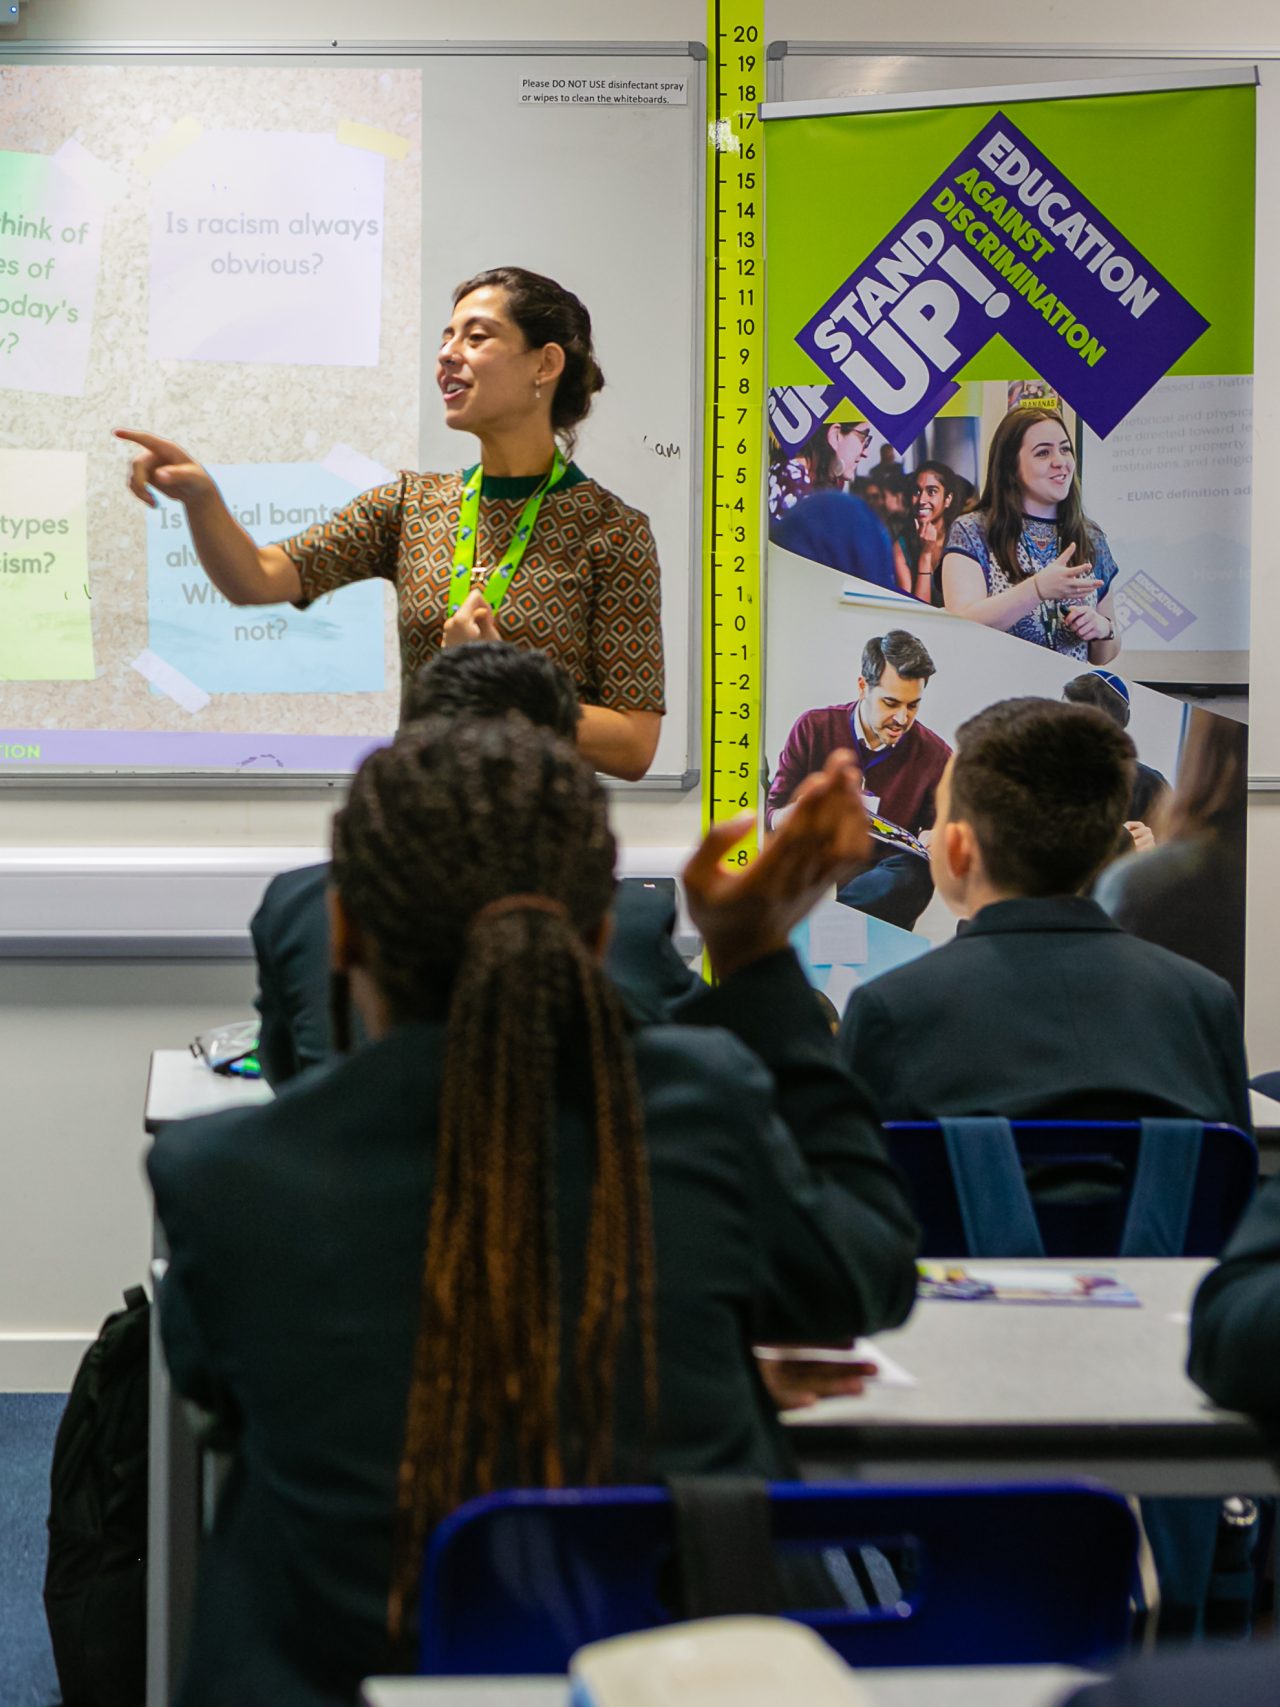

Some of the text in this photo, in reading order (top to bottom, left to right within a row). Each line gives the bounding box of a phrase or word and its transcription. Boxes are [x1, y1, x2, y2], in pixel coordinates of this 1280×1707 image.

[733, 26, 758, 43] 20
[738, 56, 756, 73] 19
[522, 79, 684, 91] Please DO NOT USE disinfectant spray
[533, 94, 558, 104] wipes
[560, 94, 570, 102] to
[571, 94, 595, 102] clean
[597, 94, 611, 102] the
[613, 94, 670, 104] whiteboards.
[738, 86, 756, 101] 18
[738, 113, 756, 130] 17
[737, 143, 756, 160] 16
[737, 173, 755, 189] 15
[737, 203, 755, 219] 14
[954, 168, 1055, 263] AGAINST
[165, 211, 379, 240] Is racism always
[977, 130, 1160, 319] EDUCATION
[61, 222, 91, 245] of
[737, 232, 755, 248] 13
[27, 258, 55, 280] of
[210, 253, 324, 276] obvious?
[737, 260, 755, 276] 12
[932, 186, 1108, 367] DISCRIMINATION
[738, 289, 754, 306] 11
[813, 218, 945, 363] STAND
[736, 319, 755, 335] 10
[839, 244, 1011, 416] UP!
[739, 349, 750, 365] 9
[738, 378, 750, 394] 8
[737, 408, 747, 424] 7
[736, 438, 747, 454] 6
[735, 468, 746, 484] 5
[1127, 490, 1163, 502] EUMC
[1167, 487, 1230, 500] definition
[734, 497, 745, 513] 4
[160, 507, 182, 529] Is
[734, 527, 746, 542] 3
[733, 556, 745, 572] 2
[736, 585, 743, 602] 1
[235, 619, 288, 641] not?
[734, 615, 746, 632] 0
[730, 645, 747, 660] -1
[729, 674, 750, 690] -2
[730, 703, 750, 719] -3
[729, 733, 750, 749] -4
[728, 763, 749, 778] -5
[728, 792, 748, 807] -6
[727, 850, 748, 867] -8
